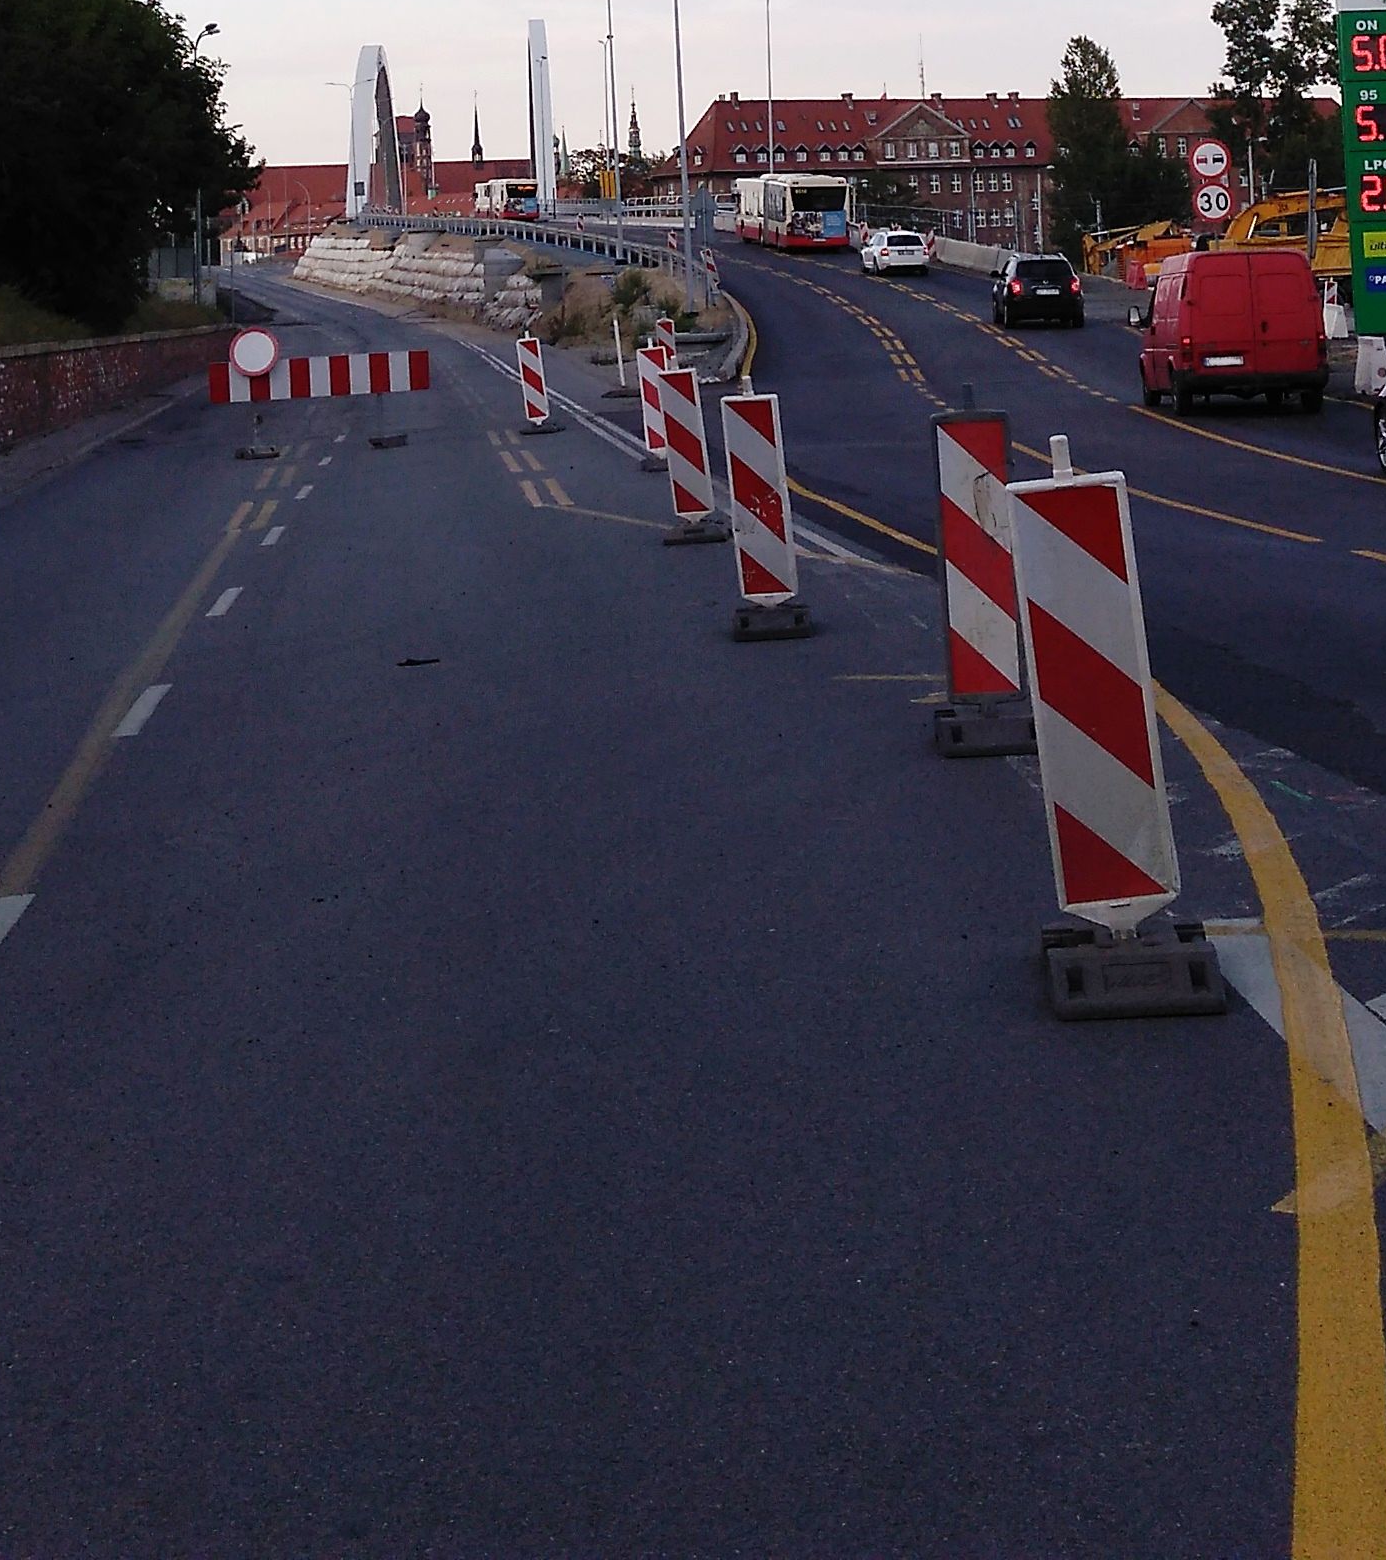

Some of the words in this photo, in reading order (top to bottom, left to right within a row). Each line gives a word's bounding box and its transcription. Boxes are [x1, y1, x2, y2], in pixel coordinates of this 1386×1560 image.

[1355, 20, 1378, 31] ON
[1359, 89, 1379, 101] 95
[1200, 192, 1229, 213] 30
